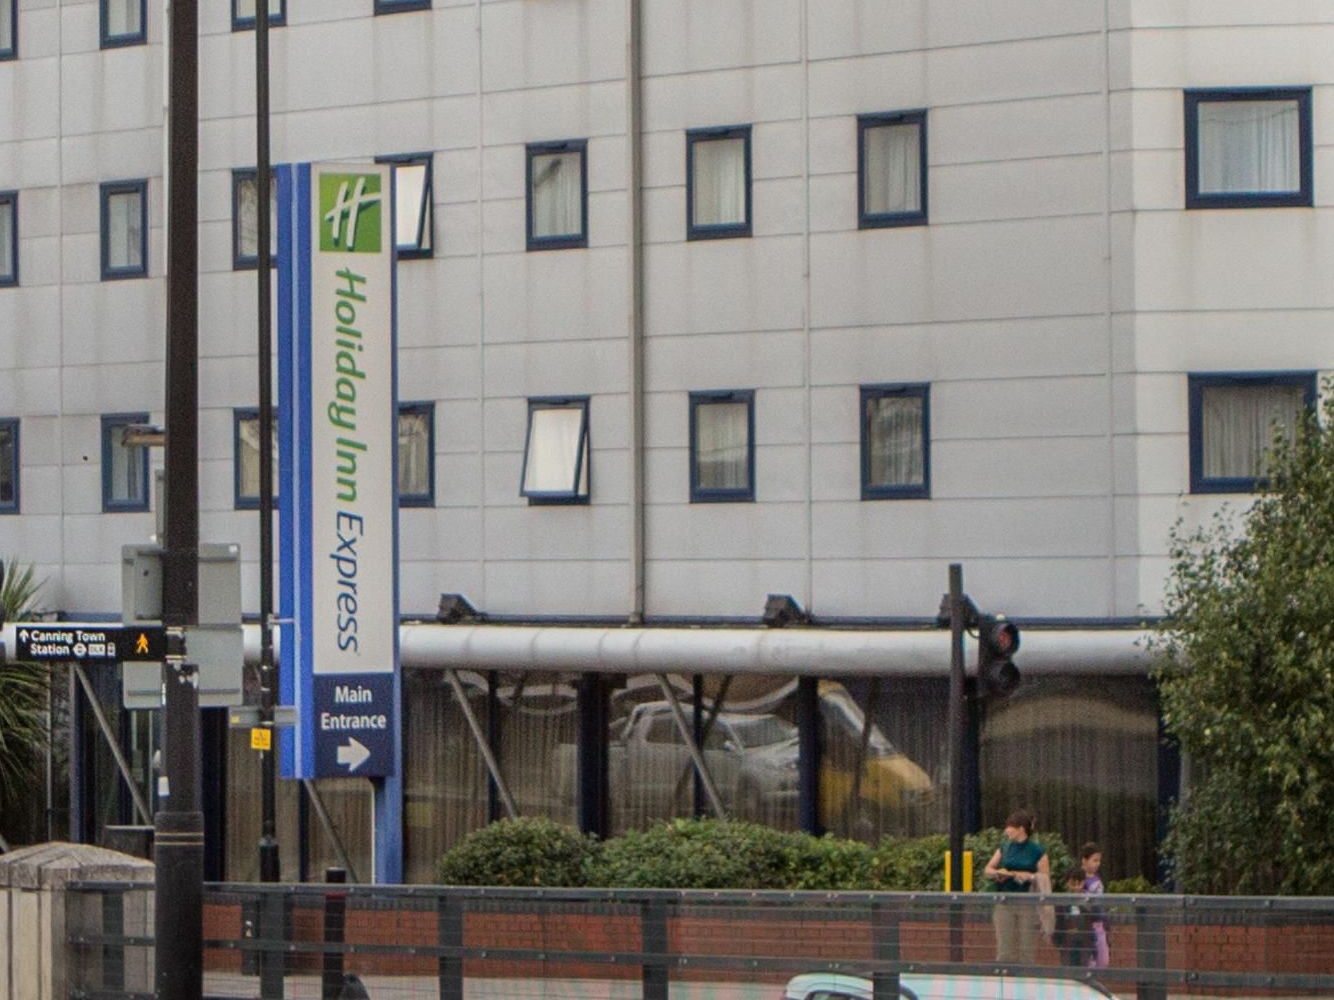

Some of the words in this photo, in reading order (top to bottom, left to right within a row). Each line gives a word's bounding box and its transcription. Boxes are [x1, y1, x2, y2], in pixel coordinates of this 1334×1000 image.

[328, 266, 366, 431] Holiday
[335, 437, 367, 502] Inn
[330, 511, 364, 652] Express
[30, 630, 73, 643] Canning
[76, 630, 106, 642] Town
[30, 642, 70, 656] Station
[335, 686, 372, 703] Main
[320, 712, 387, 730] Entrance
